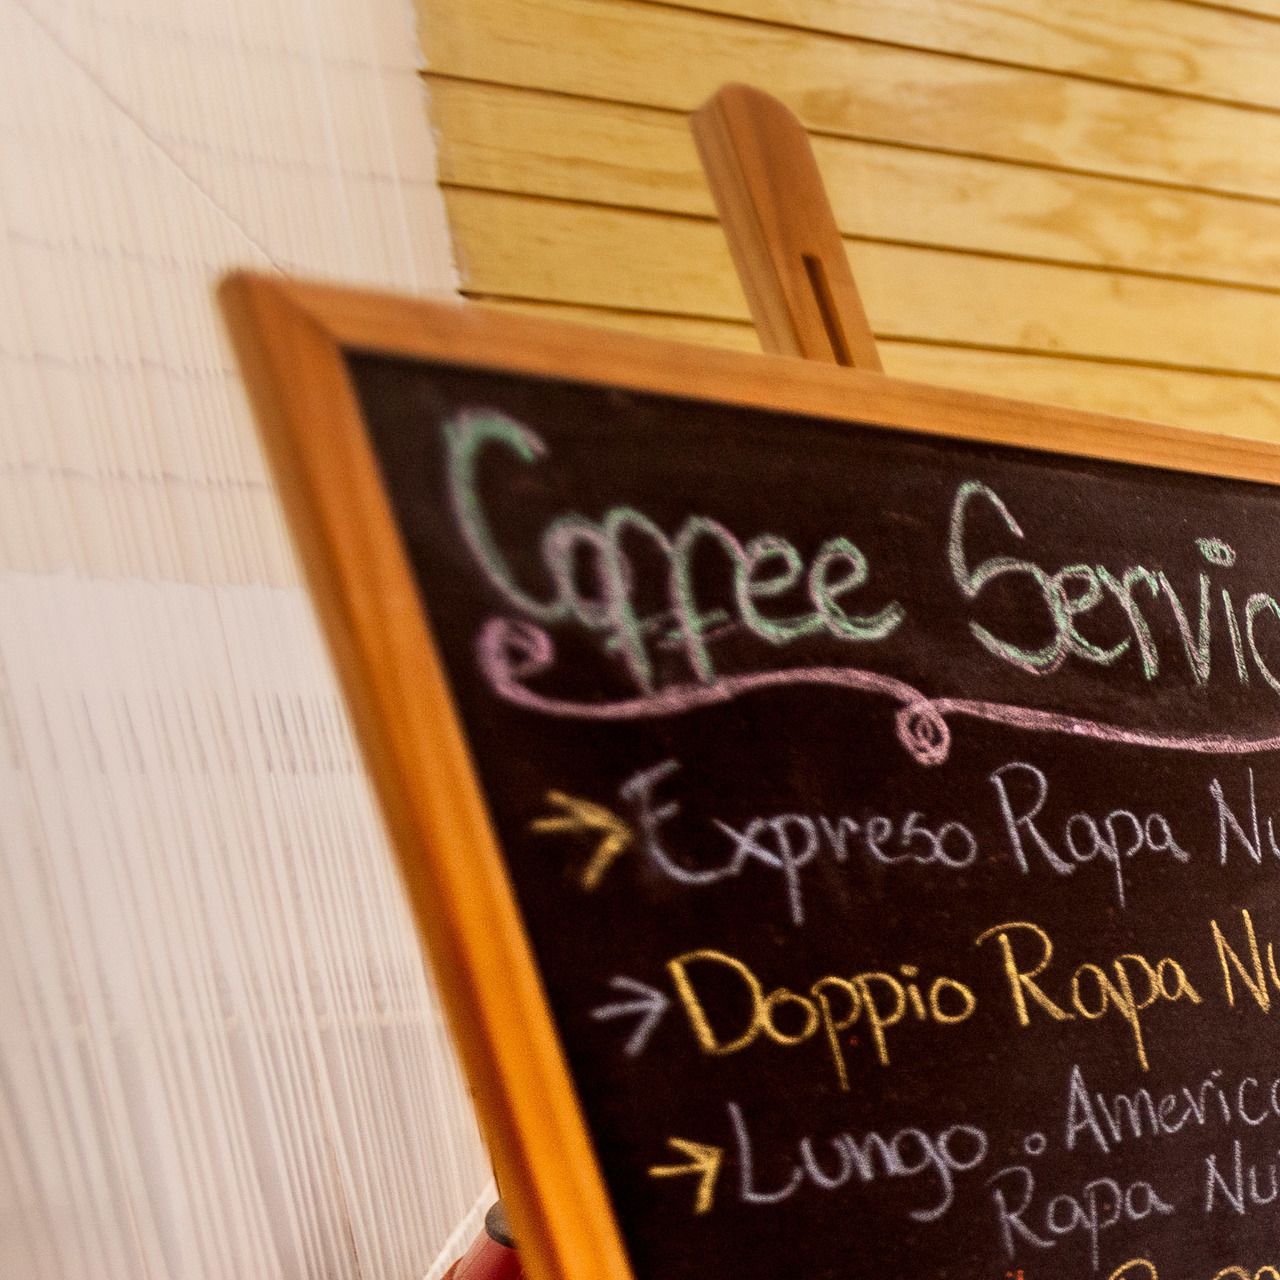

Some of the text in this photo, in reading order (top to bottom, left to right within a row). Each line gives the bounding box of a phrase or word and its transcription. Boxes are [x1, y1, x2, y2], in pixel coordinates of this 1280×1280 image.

[443, 407, 906, 693] Coffee
[619, 758, 978, 925] Expreso
[990, 761, 1191, 907] Rapa
[666, 949, 977, 1091] Doppio
[976, 922, 1201, 1072] Rapa
[727, 1101, 989, 1223] Lungo
[985, 1165, 1175, 1271] Rapa
